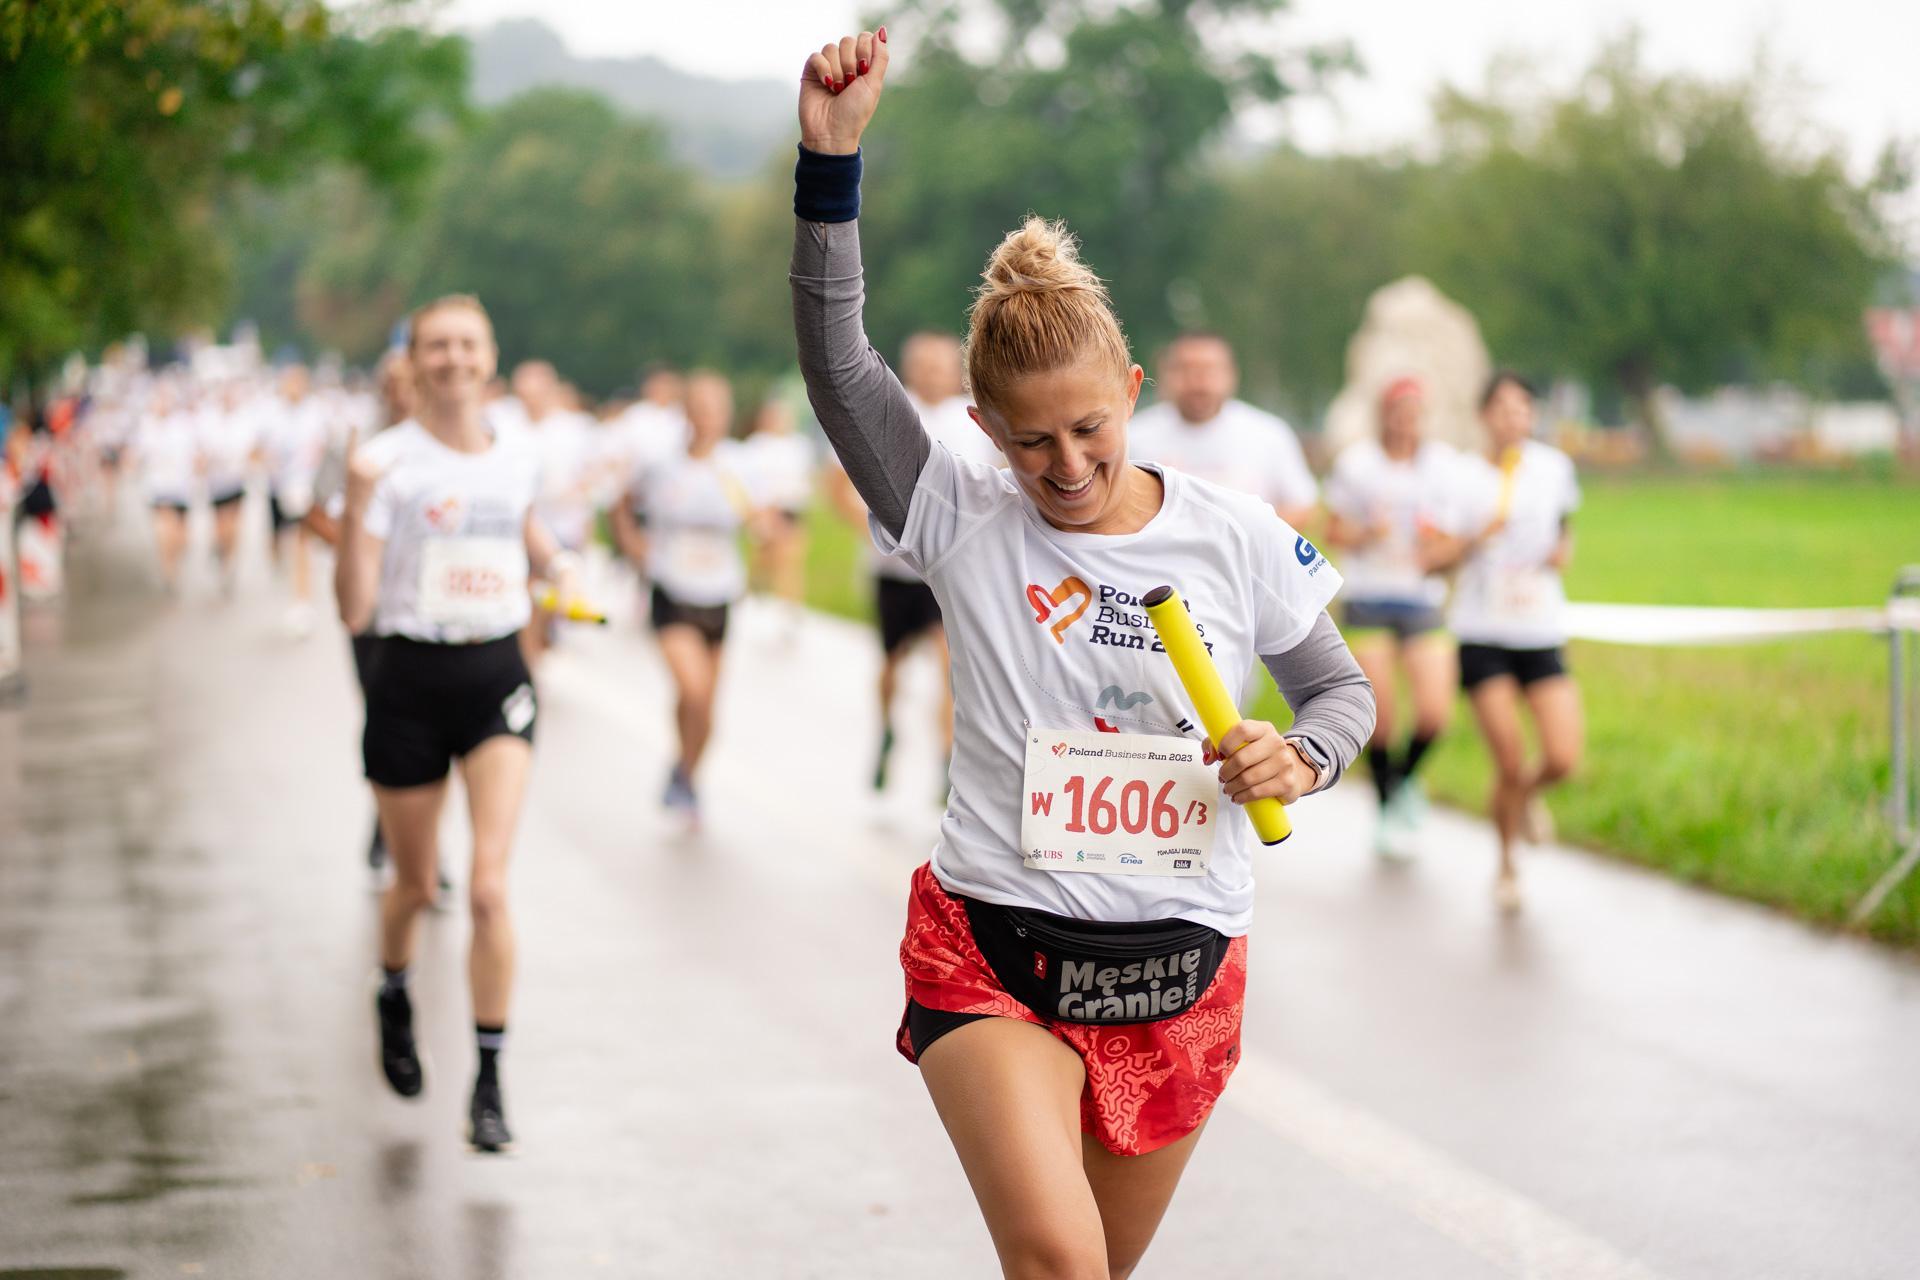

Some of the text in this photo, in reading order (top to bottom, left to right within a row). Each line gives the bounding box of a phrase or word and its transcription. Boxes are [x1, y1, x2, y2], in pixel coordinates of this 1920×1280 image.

[1095, 606, 1205, 637] Busis
[1089, 625, 1144, 649] Run
[1068, 747, 1193, 762] Poland Business Run 2023
[1031, 792, 1053, 816] W
[1043, 850, 1063, 859] UBS
[1120, 856, 1143, 864] Enea
[1059, 949, 1201, 996] Męskie
[1058, 979, 1184, 1019] Granie
[1184, 970, 1198, 1005] 2019
